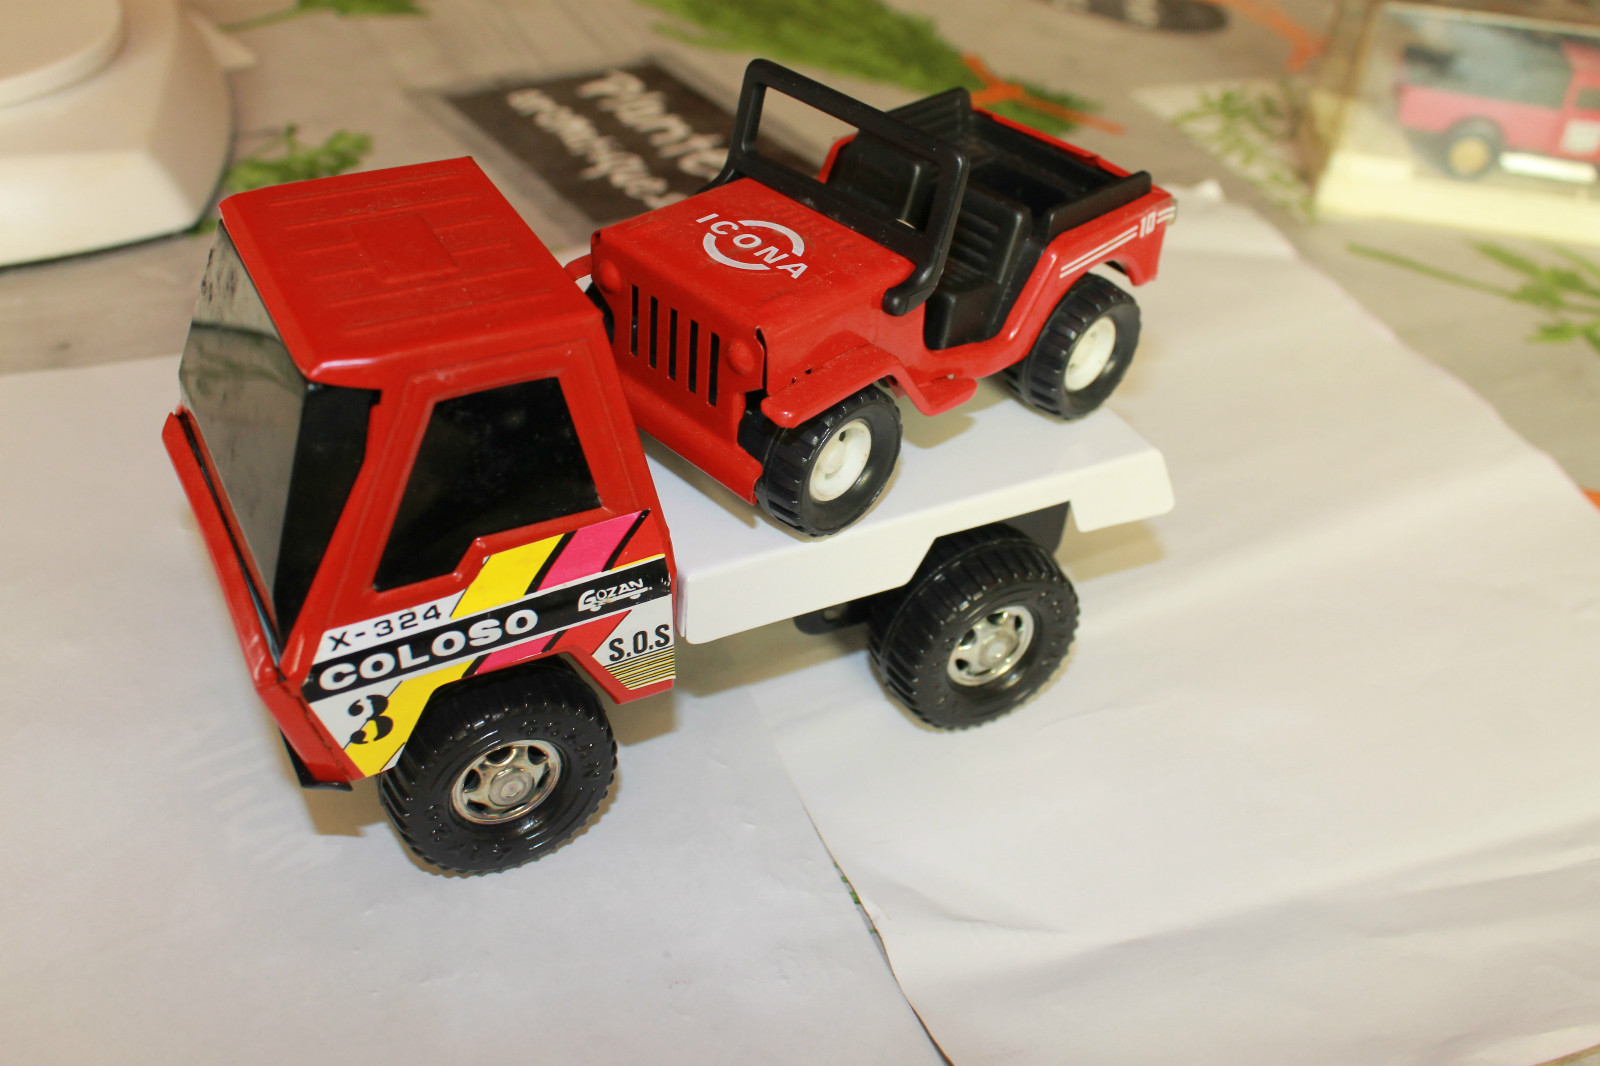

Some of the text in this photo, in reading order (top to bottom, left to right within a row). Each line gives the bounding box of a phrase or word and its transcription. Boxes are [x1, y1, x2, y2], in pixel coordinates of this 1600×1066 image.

[696, 213, 808, 279] ICONA
[1139, 211, 1156, 238] 10
[578, 579, 650, 612] GOZAN
[319, 609, 539, 691] COLOSO
[328, 604, 442, 651] X-324
[609, 624, 670, 662] S.O.S
[348, 693, 394, 746] 3
